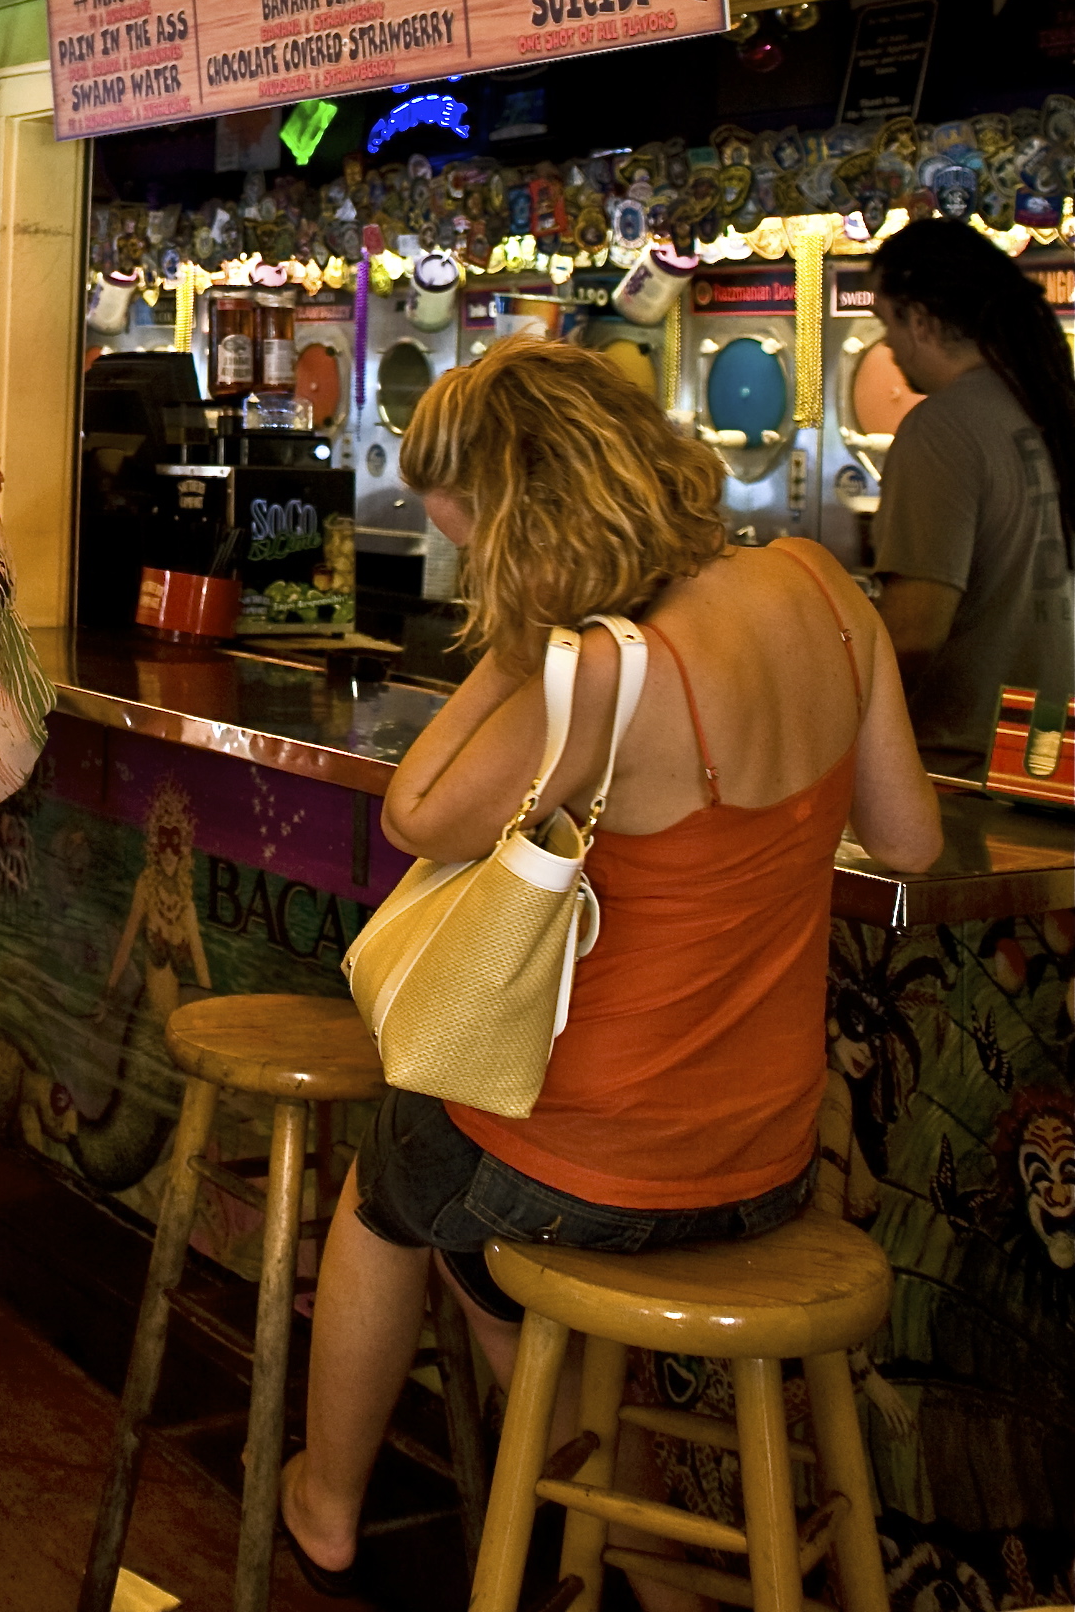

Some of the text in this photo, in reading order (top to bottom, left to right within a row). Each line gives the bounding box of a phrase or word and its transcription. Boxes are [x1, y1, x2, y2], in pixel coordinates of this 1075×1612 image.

[58, 32, 95, 66] PAIN
[101, 26, 120, 56] IN
[126, 18, 151, 51] THE
[156, 10, 189, 44] ASS
[207, 42, 279, 87] CHOCOLATE
[282, 31, 343, 72] COVERED
[348, 8, 454, 61] STRAWBERRY
[518, 10, 677, 55] ONE SHOT OF ALL FLAVORS
[71, 64, 182, 112] SWAMP WATER
[773, 282, 796, 302] Dev
[207, 855, 375, 960] BACA
